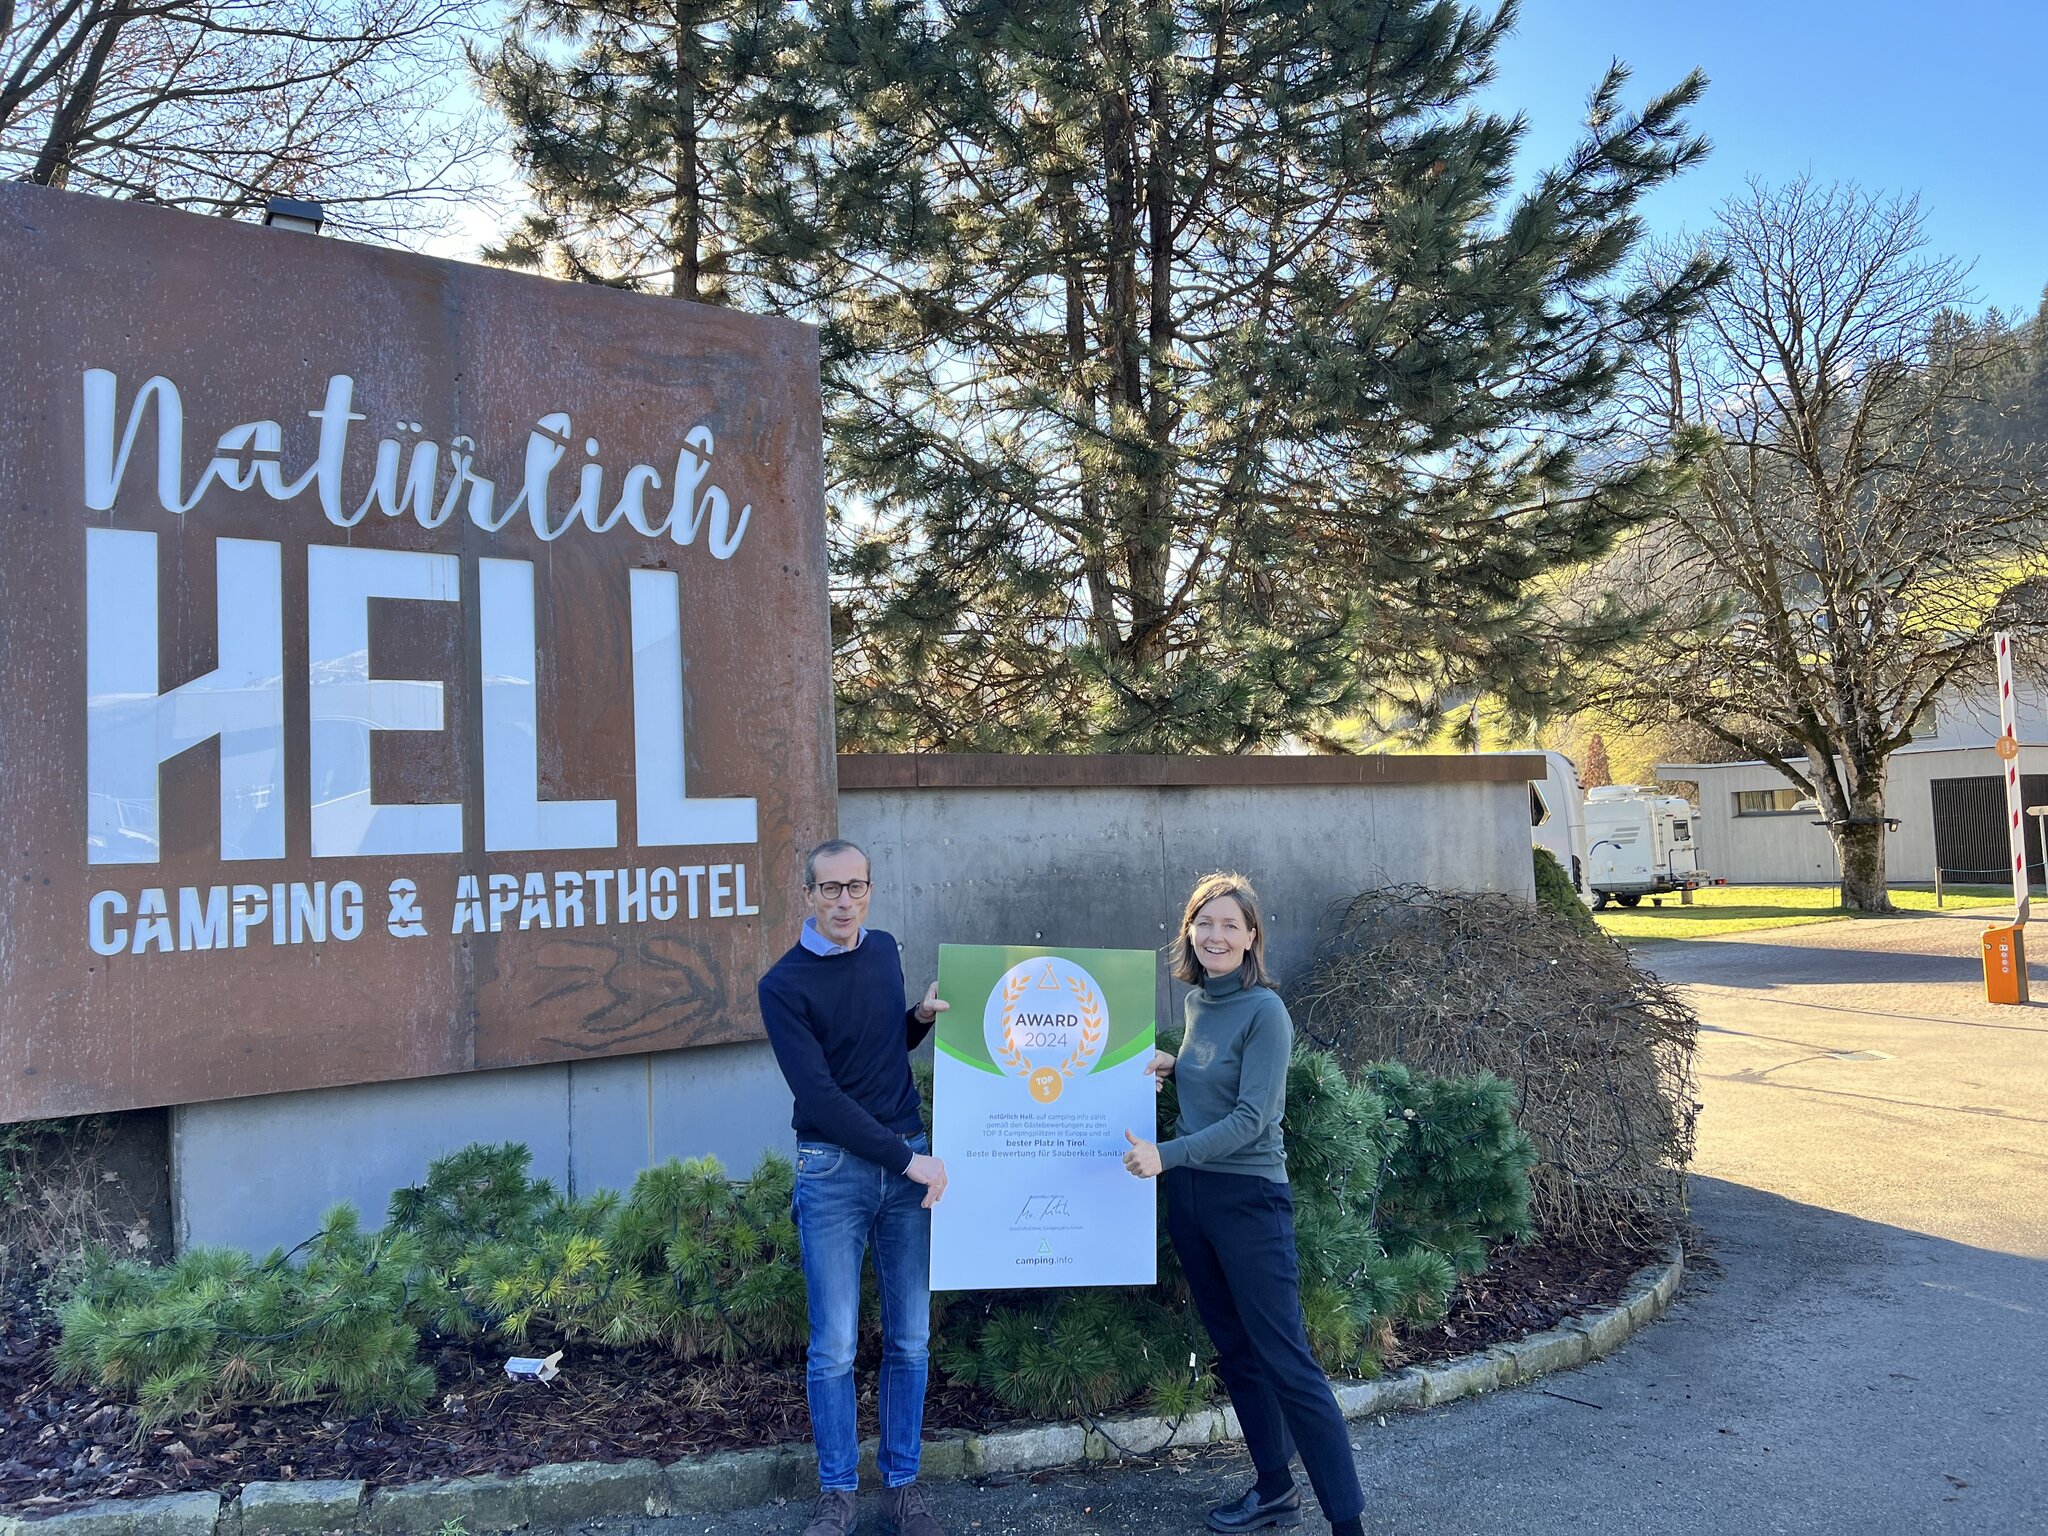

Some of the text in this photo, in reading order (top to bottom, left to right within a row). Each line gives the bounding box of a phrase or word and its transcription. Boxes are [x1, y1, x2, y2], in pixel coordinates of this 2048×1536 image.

[83, 368, 752, 560] Natürlich
[86, 527, 758, 865] HELL
[88, 863, 760, 956] CAMPING & APARTHOTEL
[1015, 1013, 1078, 1027] AWARD
[1024, 1032, 1068, 1047] 2024
[1036, 1075, 1054, 1086] TOP
[1042, 1086, 1050, 1096] 3
[1064, 1129, 1088, 1138] Europa
[1006, 1139, 1032, 1147] bester
[1034, 1139, 1055, 1147] Platz
[1056, 1139, 1065, 1147] in
[966, 1149, 990, 1158] Beste
[991, 1149, 1036, 1159] Bewertung
[1038, 1149, 1051, 1157] für
[1052, 1149, 1096, 1158] Sauberkeit
[1015, 1256, 1073, 1266] camping.info
